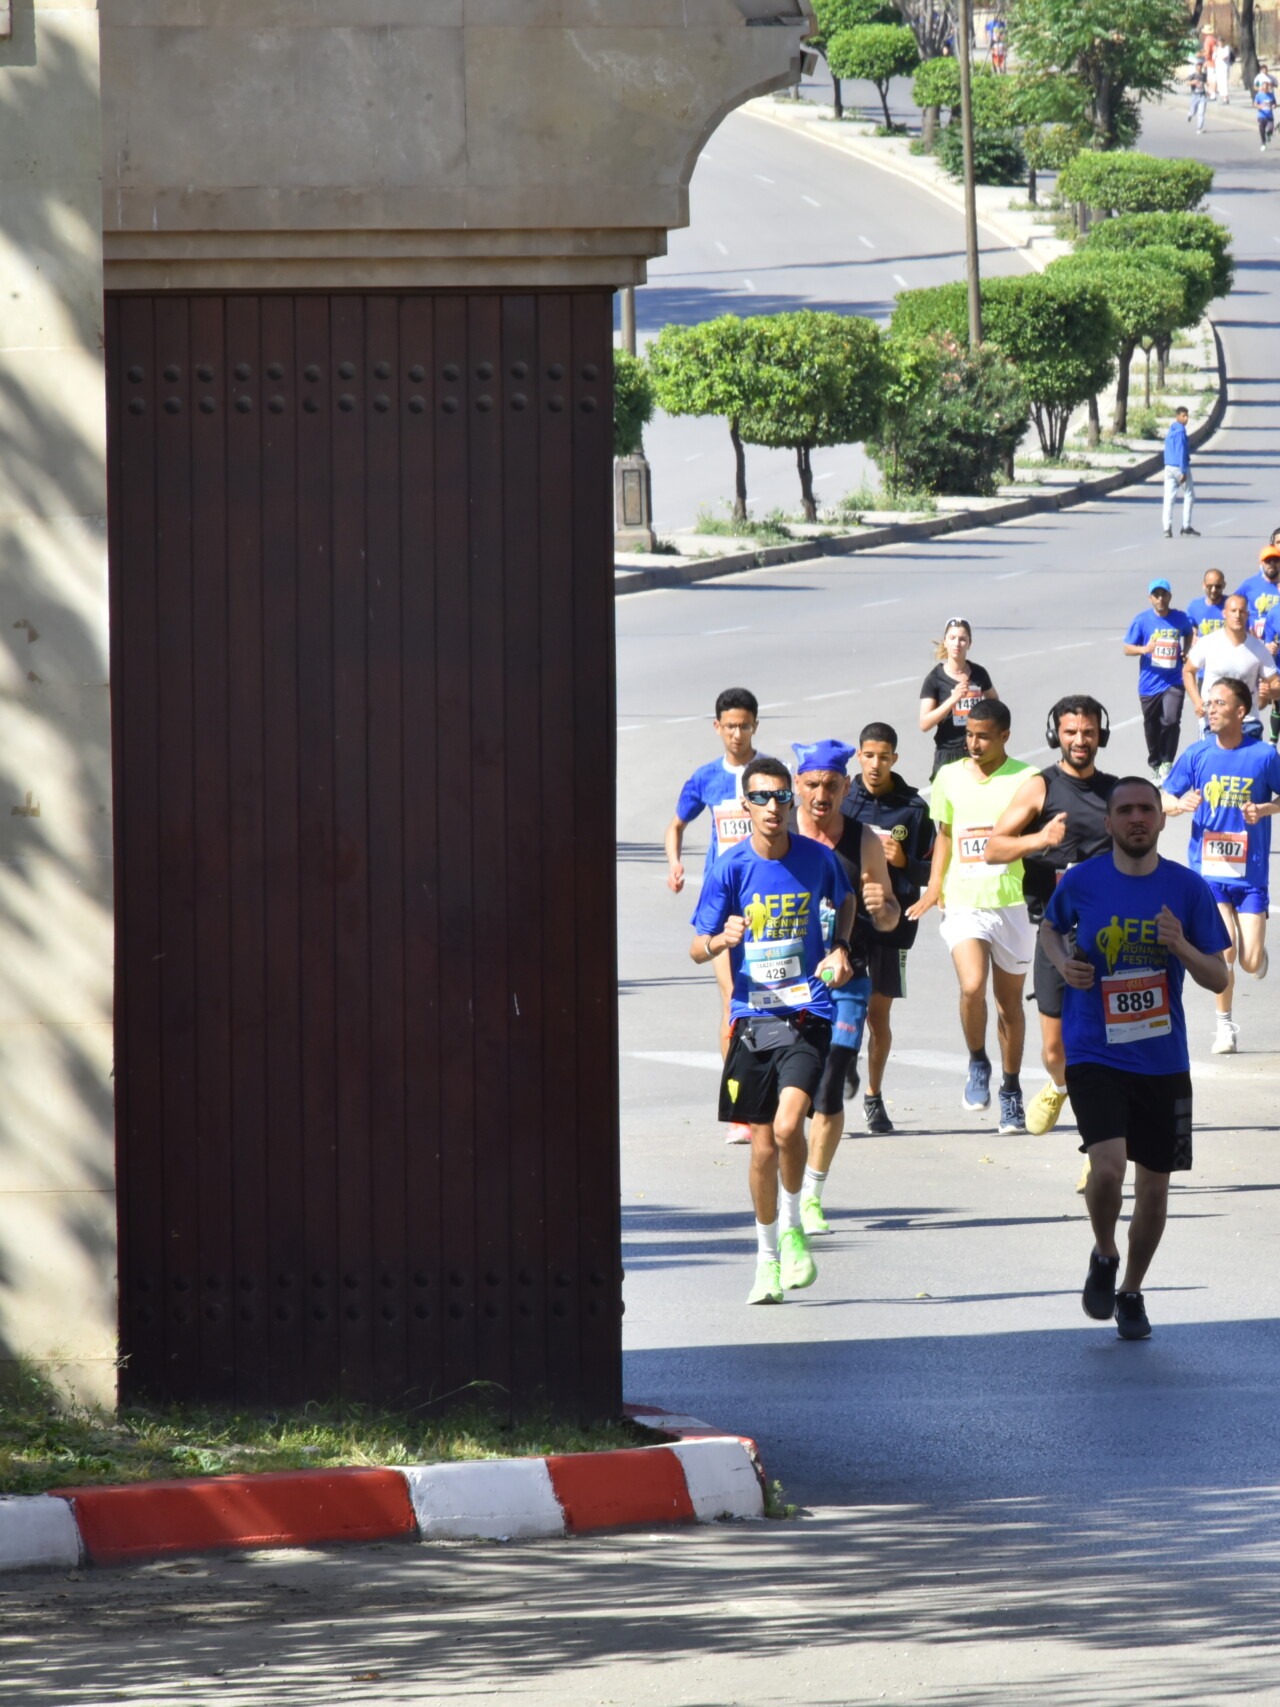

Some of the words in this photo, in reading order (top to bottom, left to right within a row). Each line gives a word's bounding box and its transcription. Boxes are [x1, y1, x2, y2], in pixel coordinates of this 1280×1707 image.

[1156, 647, 1176, 656] 1437
[1220, 775, 1254, 794] FEZ
[1209, 841, 1241, 856] 1307
[764, 892, 811, 920] FEZ
[766, 917, 809, 929] RUNNING
[766, 927, 808, 939] FESTIVAL
[766, 968, 787, 979] 429
[1117, 990, 1154, 1013] 889
